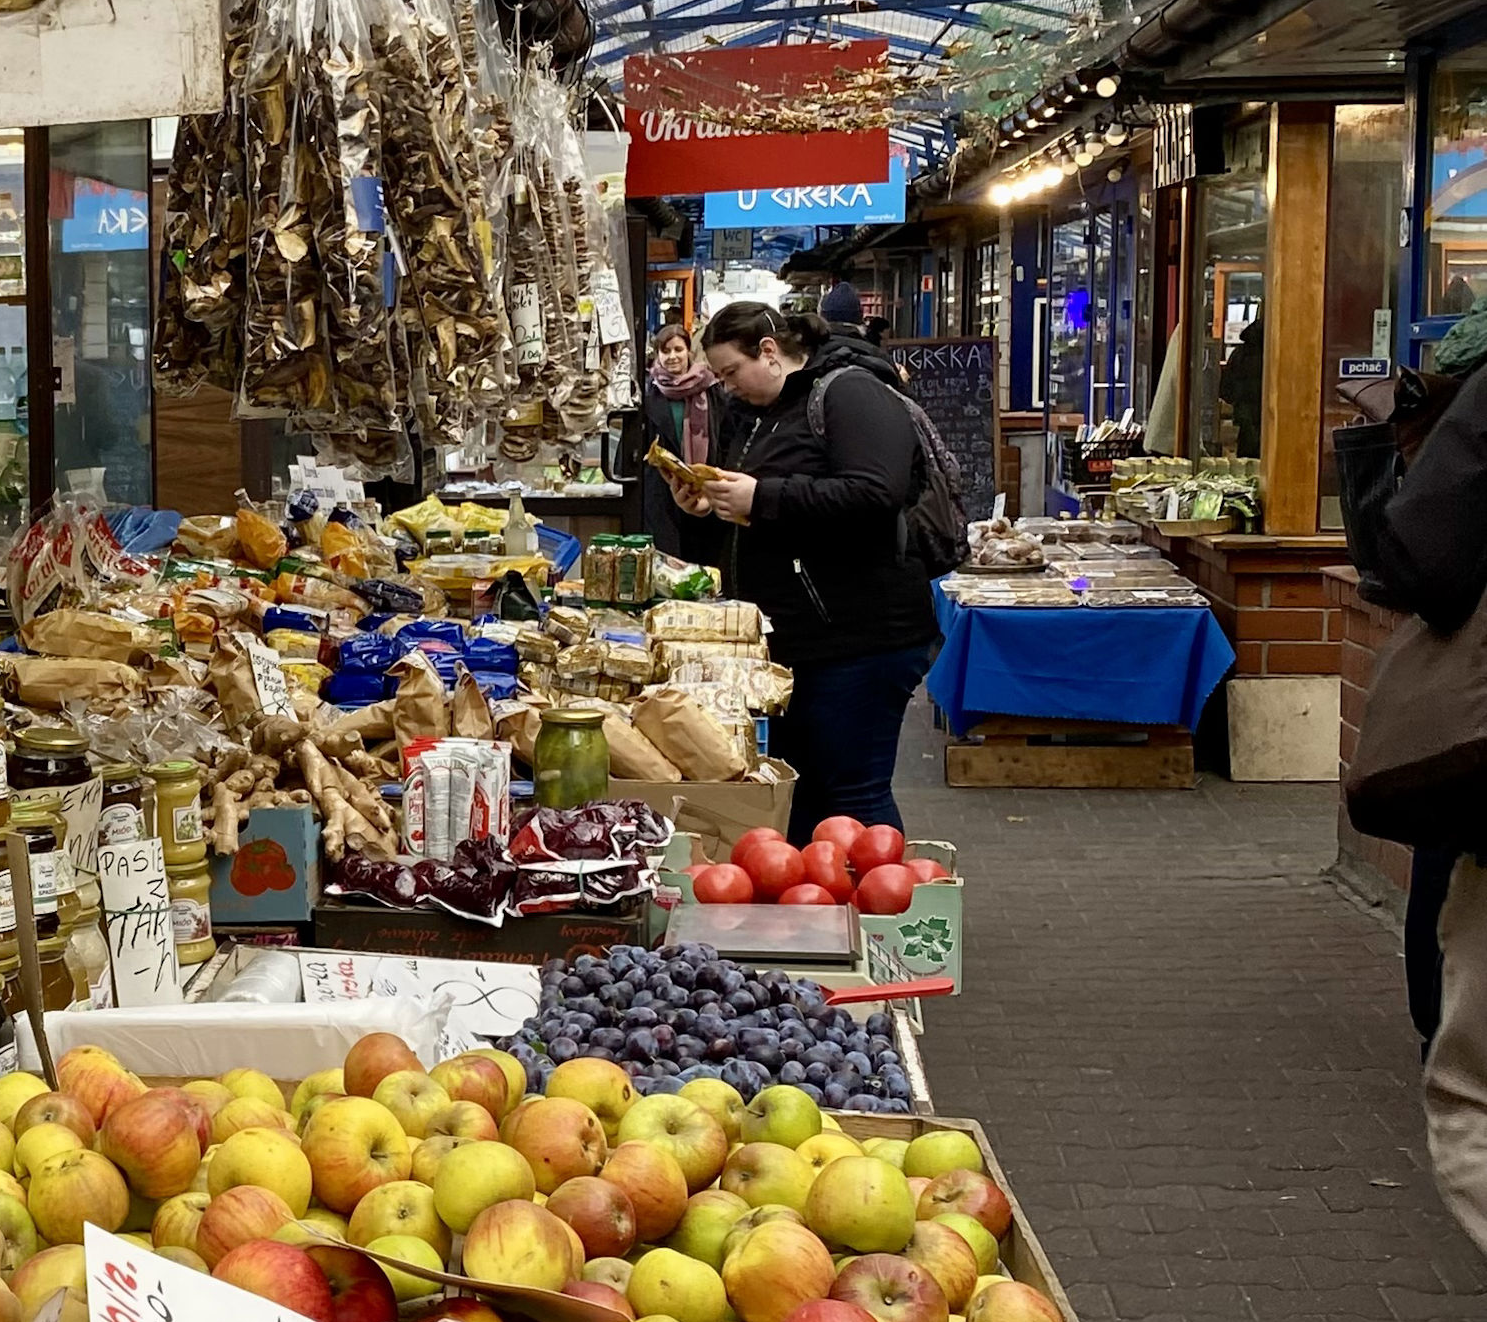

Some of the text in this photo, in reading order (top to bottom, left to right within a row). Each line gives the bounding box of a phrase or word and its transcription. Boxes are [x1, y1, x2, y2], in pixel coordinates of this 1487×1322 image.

[770, 183, 873, 209] GREKA
[908, 345, 983, 370] GREKA
[1348, 361, 1382, 374] pchać
